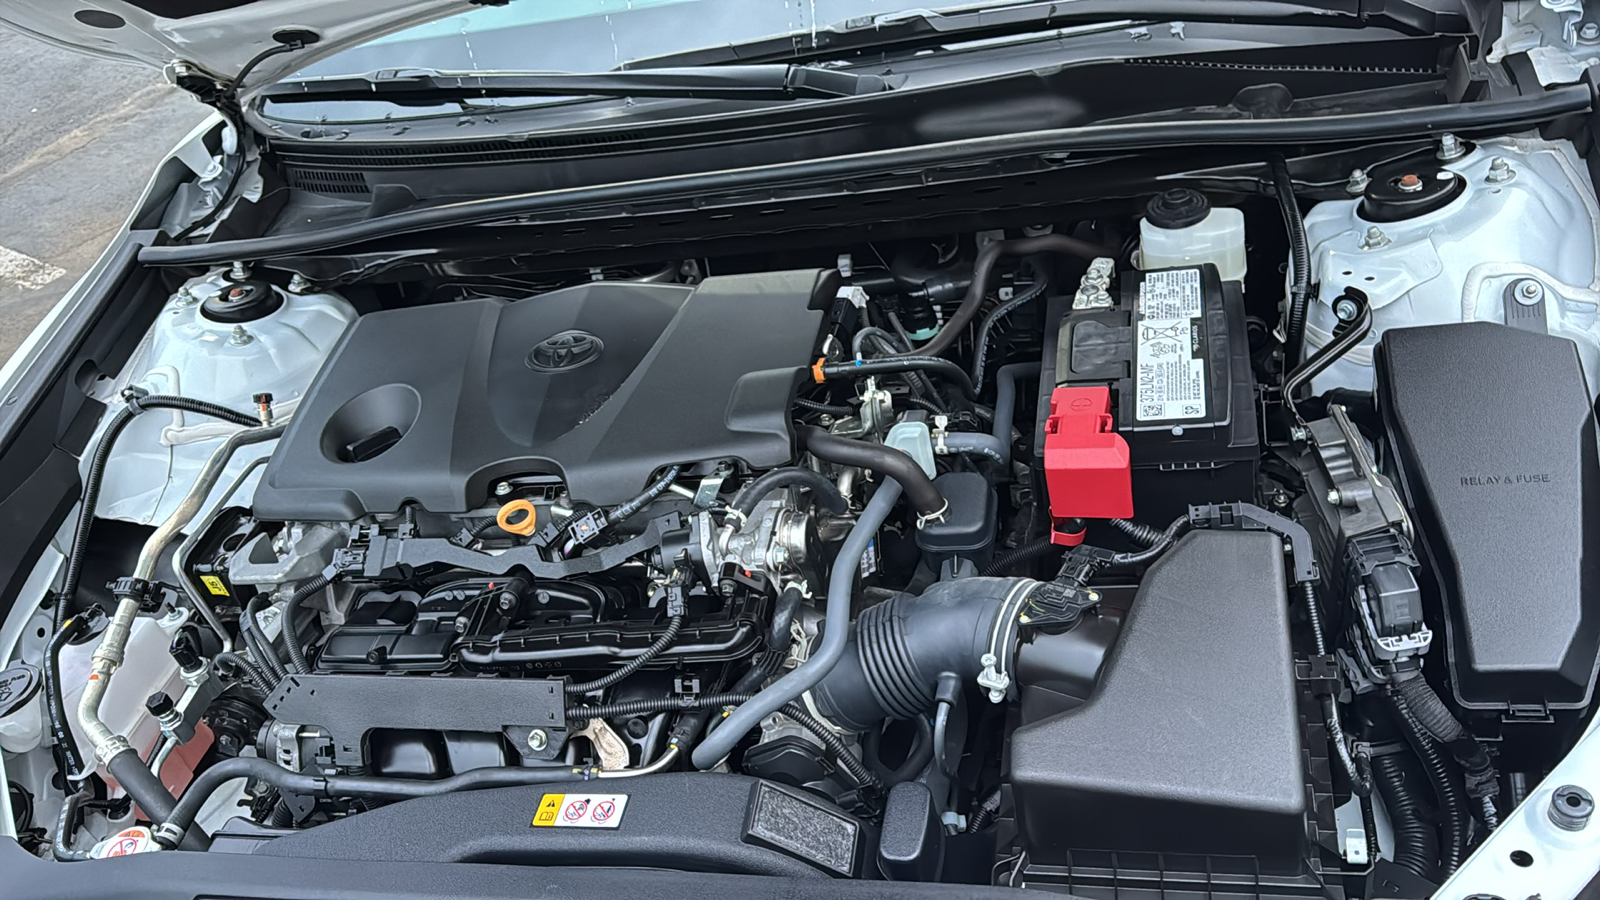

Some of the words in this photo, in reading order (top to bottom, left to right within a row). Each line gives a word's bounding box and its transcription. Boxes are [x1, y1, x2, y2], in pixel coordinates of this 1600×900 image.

[1191, 324, 1199, 344] CLARIOS
[1139, 363, 1155, 403] 375LN2-MF
[1184, 405, 1200, 415] SP
[1460, 475, 1501, 487] RELAY
[1504, 475, 1513, 485] &
[1516, 473, 1551, 484] FUSE
